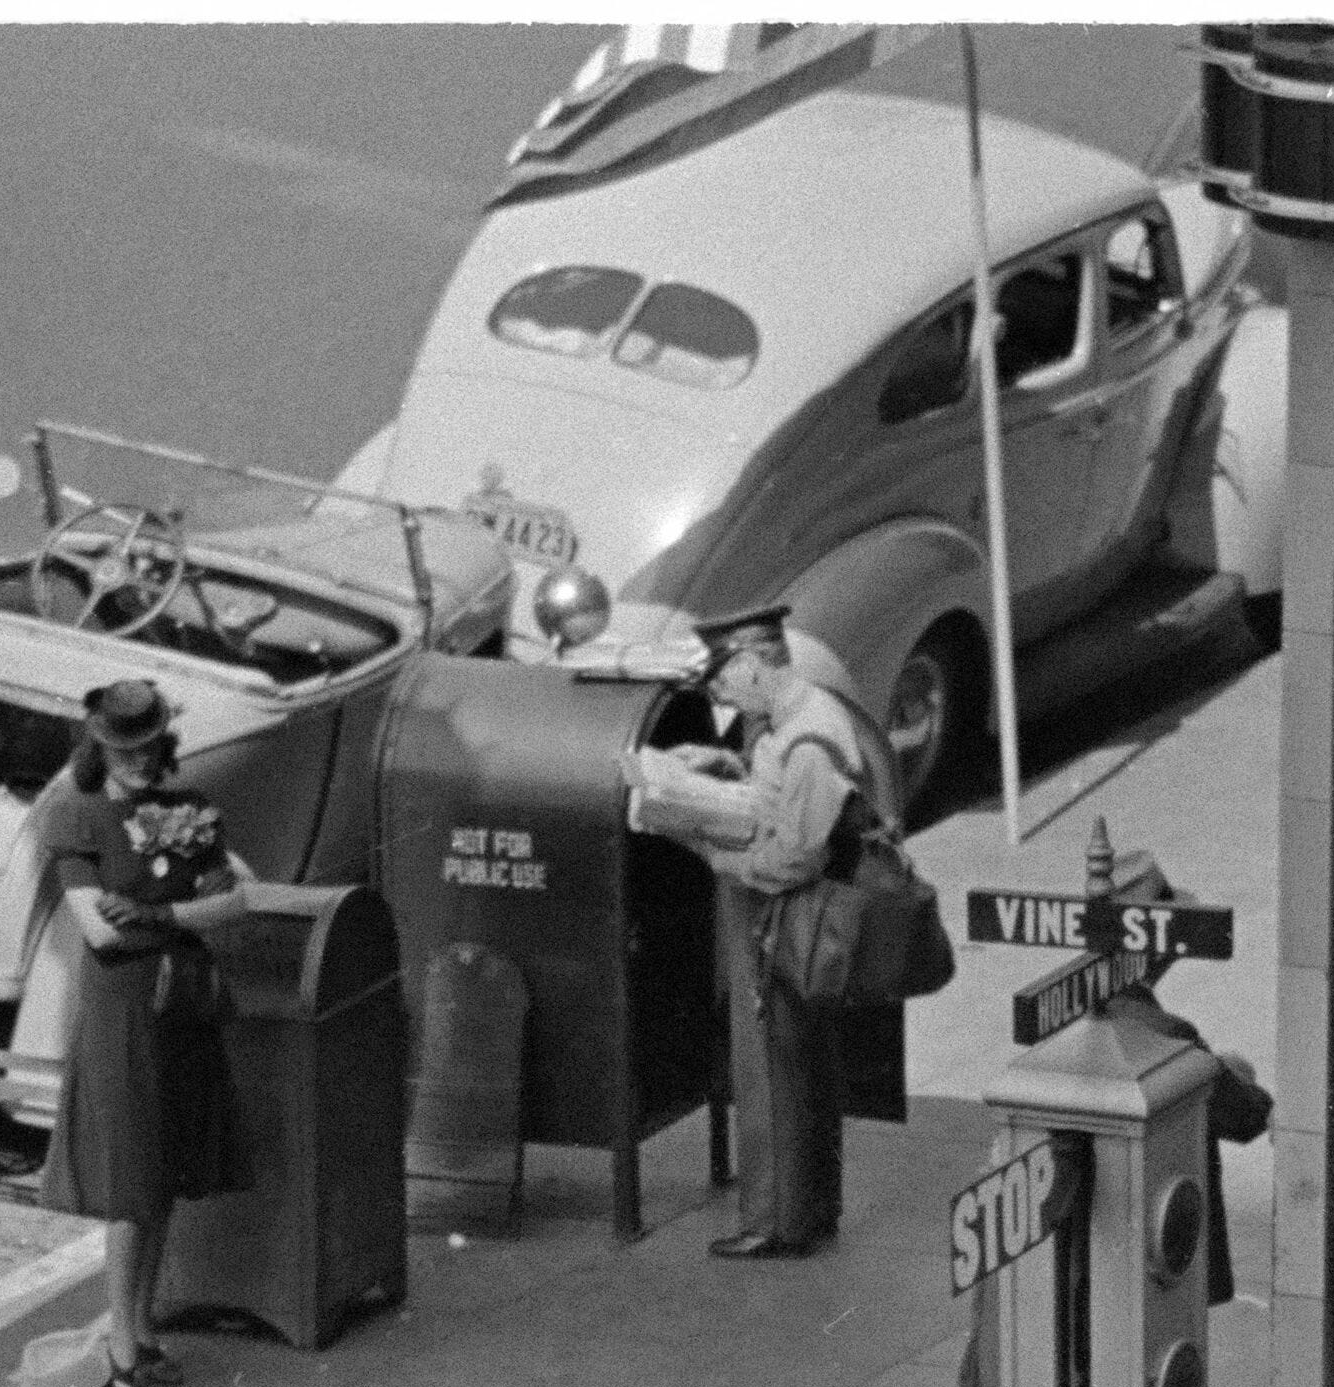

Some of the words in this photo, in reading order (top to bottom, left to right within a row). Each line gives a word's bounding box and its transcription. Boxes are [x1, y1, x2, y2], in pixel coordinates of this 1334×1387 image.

[451, 827, 487, 853] NOT
[493, 829, 533, 858] FOR
[442, 856, 509, 888] PUBLIC
[512, 861, 548, 890] USE
[995, 897, 1086, 946] VINE
[1121, 908, 1188, 955] ST.
[953, 1142, 1055, 1291] STOP
